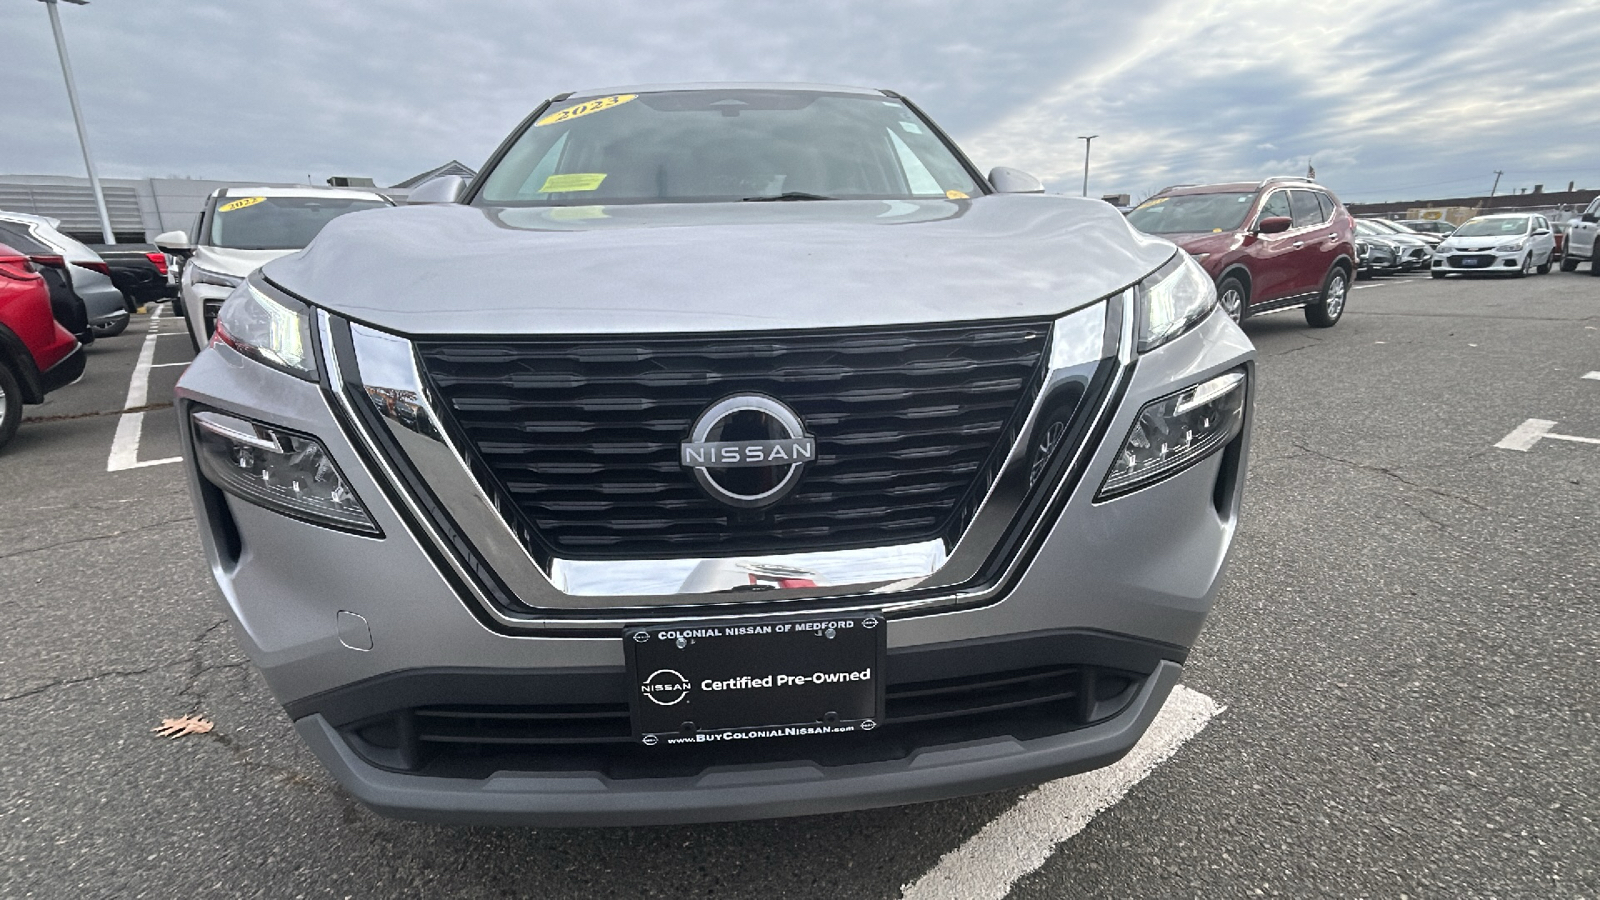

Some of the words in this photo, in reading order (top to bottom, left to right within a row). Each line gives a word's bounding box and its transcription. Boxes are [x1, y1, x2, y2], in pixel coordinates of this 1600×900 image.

[555, 96, 619, 121] 2023
[685, 442, 811, 463] NISSAN
[658, 628, 722, 640] COLONIAL
[725, 626, 772, 636] NISSAN
[775, 624, 792, 633] OF
[795, 620, 854, 631] MEDFORD
[641, 682, 691, 692] NISSAN
[701, 675, 773, 691] Certified
[776, 667, 871, 687] Pre-Owned
